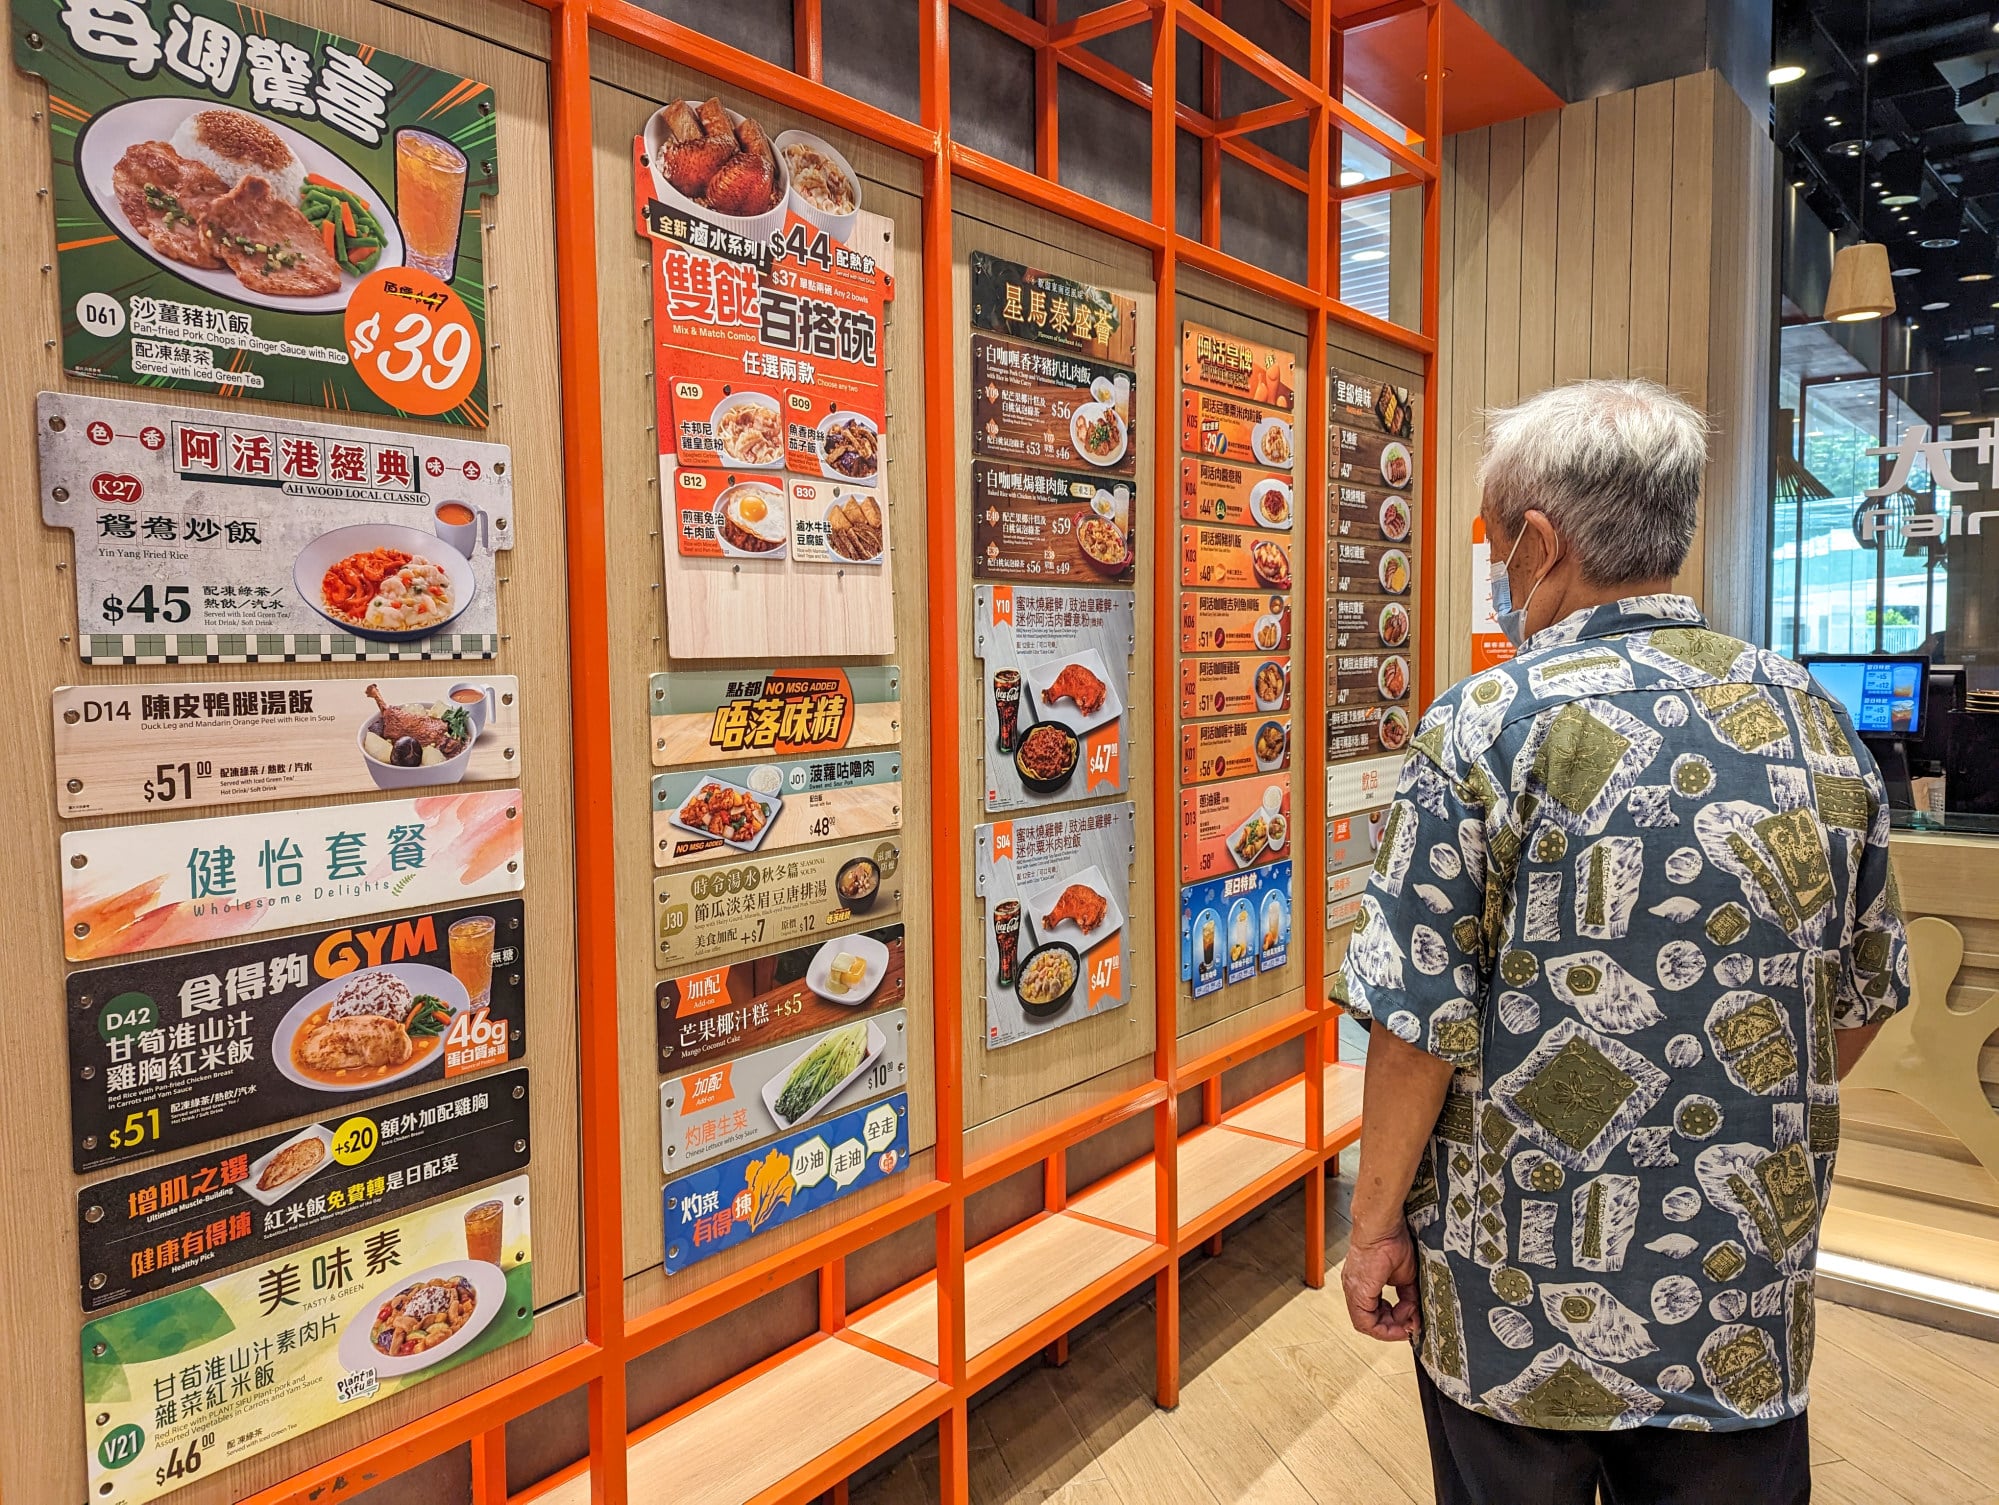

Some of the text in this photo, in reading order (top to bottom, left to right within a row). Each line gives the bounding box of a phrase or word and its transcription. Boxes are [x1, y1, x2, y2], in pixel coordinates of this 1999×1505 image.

[61, 0, 395, 144] 每週驚喜
[659, 216, 688, 239] 全新
[770, 224, 875, 276] $44 配熱飲
[772, 270, 798, 289] $37
[86, 304, 116, 326] D61
[133, 299, 249, 334] 沙薑豬扒飯
[761, 290, 876, 365] 百搭碗
[134, 322, 346, 362] Pan-fried Pork Chops Ginger Sauce with Rice
[673, 325, 757, 342] Mix Match Combo
[135, 341, 210, 366] 配凍綠茶
[350, 312, 471, 390] $39
[135, 361, 262, 385] Served with Iced Green Tea
[742, 350, 815, 384] 任選兩款
[680, 386, 699, 397] A19
[792, 396, 810, 409] B09
[1052, 401, 1071, 419] $56
[1187, 414, 1197, 428] K05
[681, 421, 712, 436] 卡邦尼
[179, 426, 411, 488] 阿活港經典
[1026, 442, 1040, 455] $53
[97, 480, 136, 500] K27
[287, 484, 426, 503] AH WOOD LOCAL CLASSIC
[683, 475, 702, 487] B12
[796, 487, 815, 498] B30
[986, 511, 1000, 520] E40
[1052, 518, 1070, 535] $59
[96, 514, 261, 544] 鴛鴦炒飯
[684, 525, 715, 539] 牛肉飯
[797, 534, 824, 546] 豆腐飯
[99, 548, 114, 557] Yin
[117, 549, 141, 559] Yang
[143, 550, 167, 559] Fried
[1027, 561, 1040, 573] $56
[1056, 562, 1070, 574] $49
[103, 585, 191, 626] $45
[996, 600, 1009, 613] Y10
[765, 681, 783, 695] NO
[786, 681, 807, 694] MSG
[809, 680, 838, 692] ADDED
[84, 690, 313, 723] D14 陳皮鴨腿湯飯
[141, 722, 161, 730] Duck
[163, 721, 177, 730] Leg
[195, 719, 230, 728] Mandarin
[233, 718, 259, 727] Orange
[261, 717, 276, 725] Peel
[295, 715, 309, 723] Rice
[318, 714, 335, 723] Soup
[711, 696, 847, 750] 唔落味精
[1090, 744, 1111, 773] $47
[144, 763, 191, 803] $51
[790, 760, 875, 785] J01 菠蘿咕嚕肉
[810, 817, 829, 836] $48
[996, 835, 1010, 848] S04
[186, 823, 428, 900] 健怡套餐
[694, 868, 759, 895] 時令湯水
[193, 880, 390, 917] Wholesome Delights
[664, 912, 683, 931] J30
[800, 915, 815, 933] $12
[178, 916, 438, 1019] 食得夠 GYM
[1091, 957, 1112, 990] $47
[687, 974, 721, 1001] 加配
[107, 1008, 151, 1030] D42
[448, 1009, 506, 1047] 46g
[678, 993, 802, 1047] 芒果椰汁糕 +$5
[107, 1037, 254, 1093] 雞胸紅米飯
[868, 1064, 886, 1089] $10
[108, 1069, 234, 1102] Red Rice with Pan-fried Chicken Breast
[117, 1098, 142, 1108] Carrots
[174, 1086, 193, 1095] Sauce
[693, 1071, 723, 1098] 加配
[109, 1108, 160, 1148] $51
[335, 1093, 489, 1155] +$20 額外加配雞胸
[868, 1116, 894, 1141] 全走
[796, 1146, 824, 1176] 少油
[834, 1150, 862, 1174] 走油
[128, 1154, 249, 1219] 增肌之選
[146, 1187, 234, 1223] Ultimate Muscle-Building
[681, 1191, 719, 1225] 灼菜
[131, 1211, 252, 1279] 健康有得揀
[171, 1252, 215, 1273] Healthy Pick
[258, 1229, 403, 1318] 美味素
[303, 1283, 365, 1312] TASTY GREEN
[154, 1361, 274, 1429] 雜菜紅米飯
[192, 1412, 234, 1434] Vegetables
[104, 1430, 138, 1463] V21
[156, 1439, 201, 1486] $46
